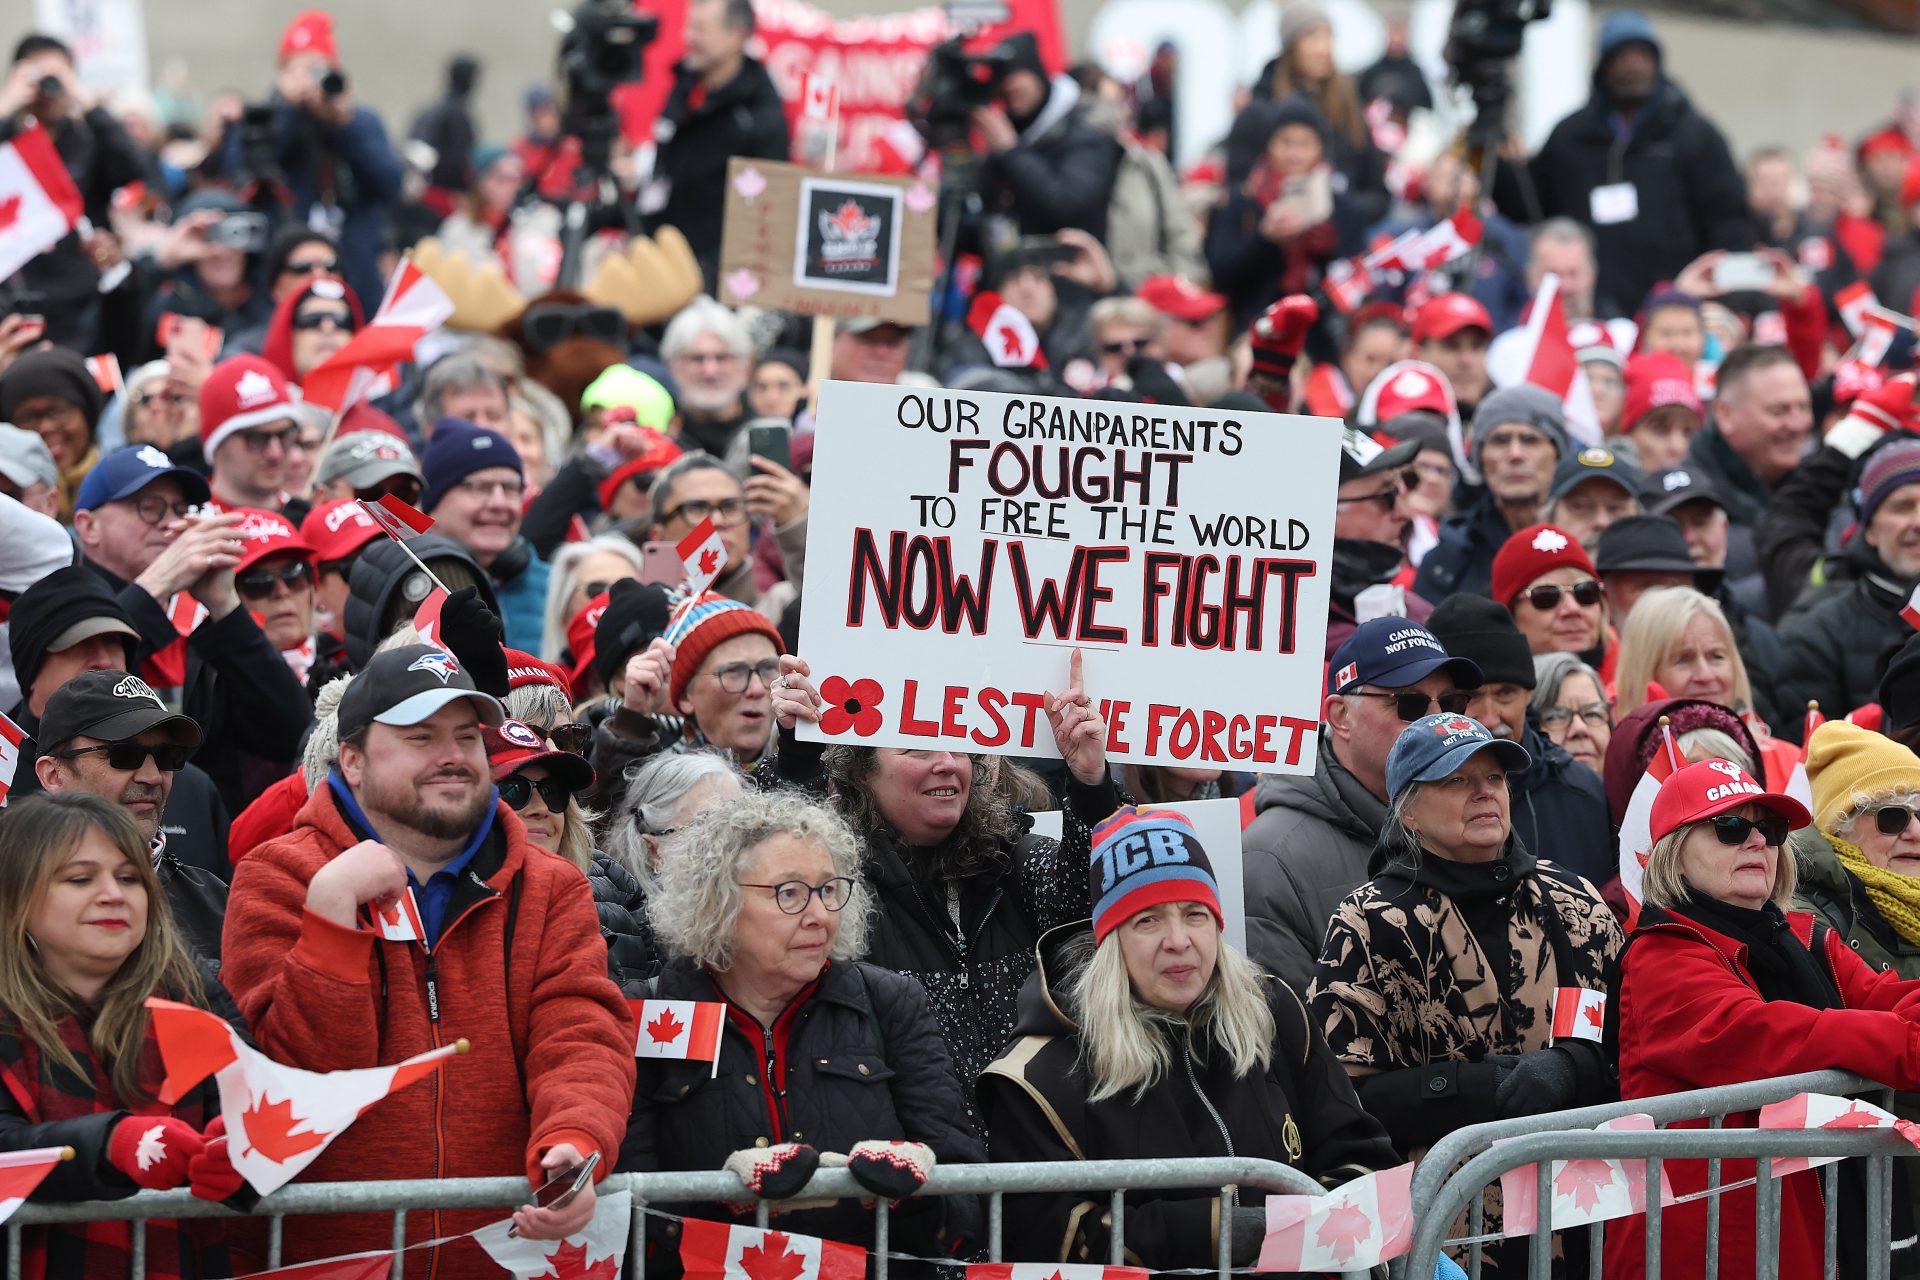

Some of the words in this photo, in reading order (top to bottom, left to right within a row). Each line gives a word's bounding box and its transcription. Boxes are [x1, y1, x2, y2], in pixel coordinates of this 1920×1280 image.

[897, 394, 980, 434] OUR
[1003, 400, 1243, 456] GRANPARENTS
[948, 438, 1194, 507] FOUGHT
[910, 495, 956, 528] TO
[980, 497, 1070, 538] FREE
[1091, 506, 1174, 545] THE
[1189, 513, 1310, 550] WORLD
[846, 527, 997, 636] NOW
[1006, 541, 1130, 644] WE
[1141, 551, 1317, 654] FIGHT
[1384, 640, 1407, 655] NOT
[1407, 637, 1427, 648] FOR
[1389, 628, 1428, 642] CANADA
[507, 666, 552, 680] ANADA
[898, 679, 1047, 748] LEST
[1145, 703, 1319, 766] FORGET
[1442, 734, 1458, 747] NOT
[1458, 730, 1475, 739] FOR
[1706, 781, 1766, 801] CANAD
[1102, 829, 1191, 894] JCB
